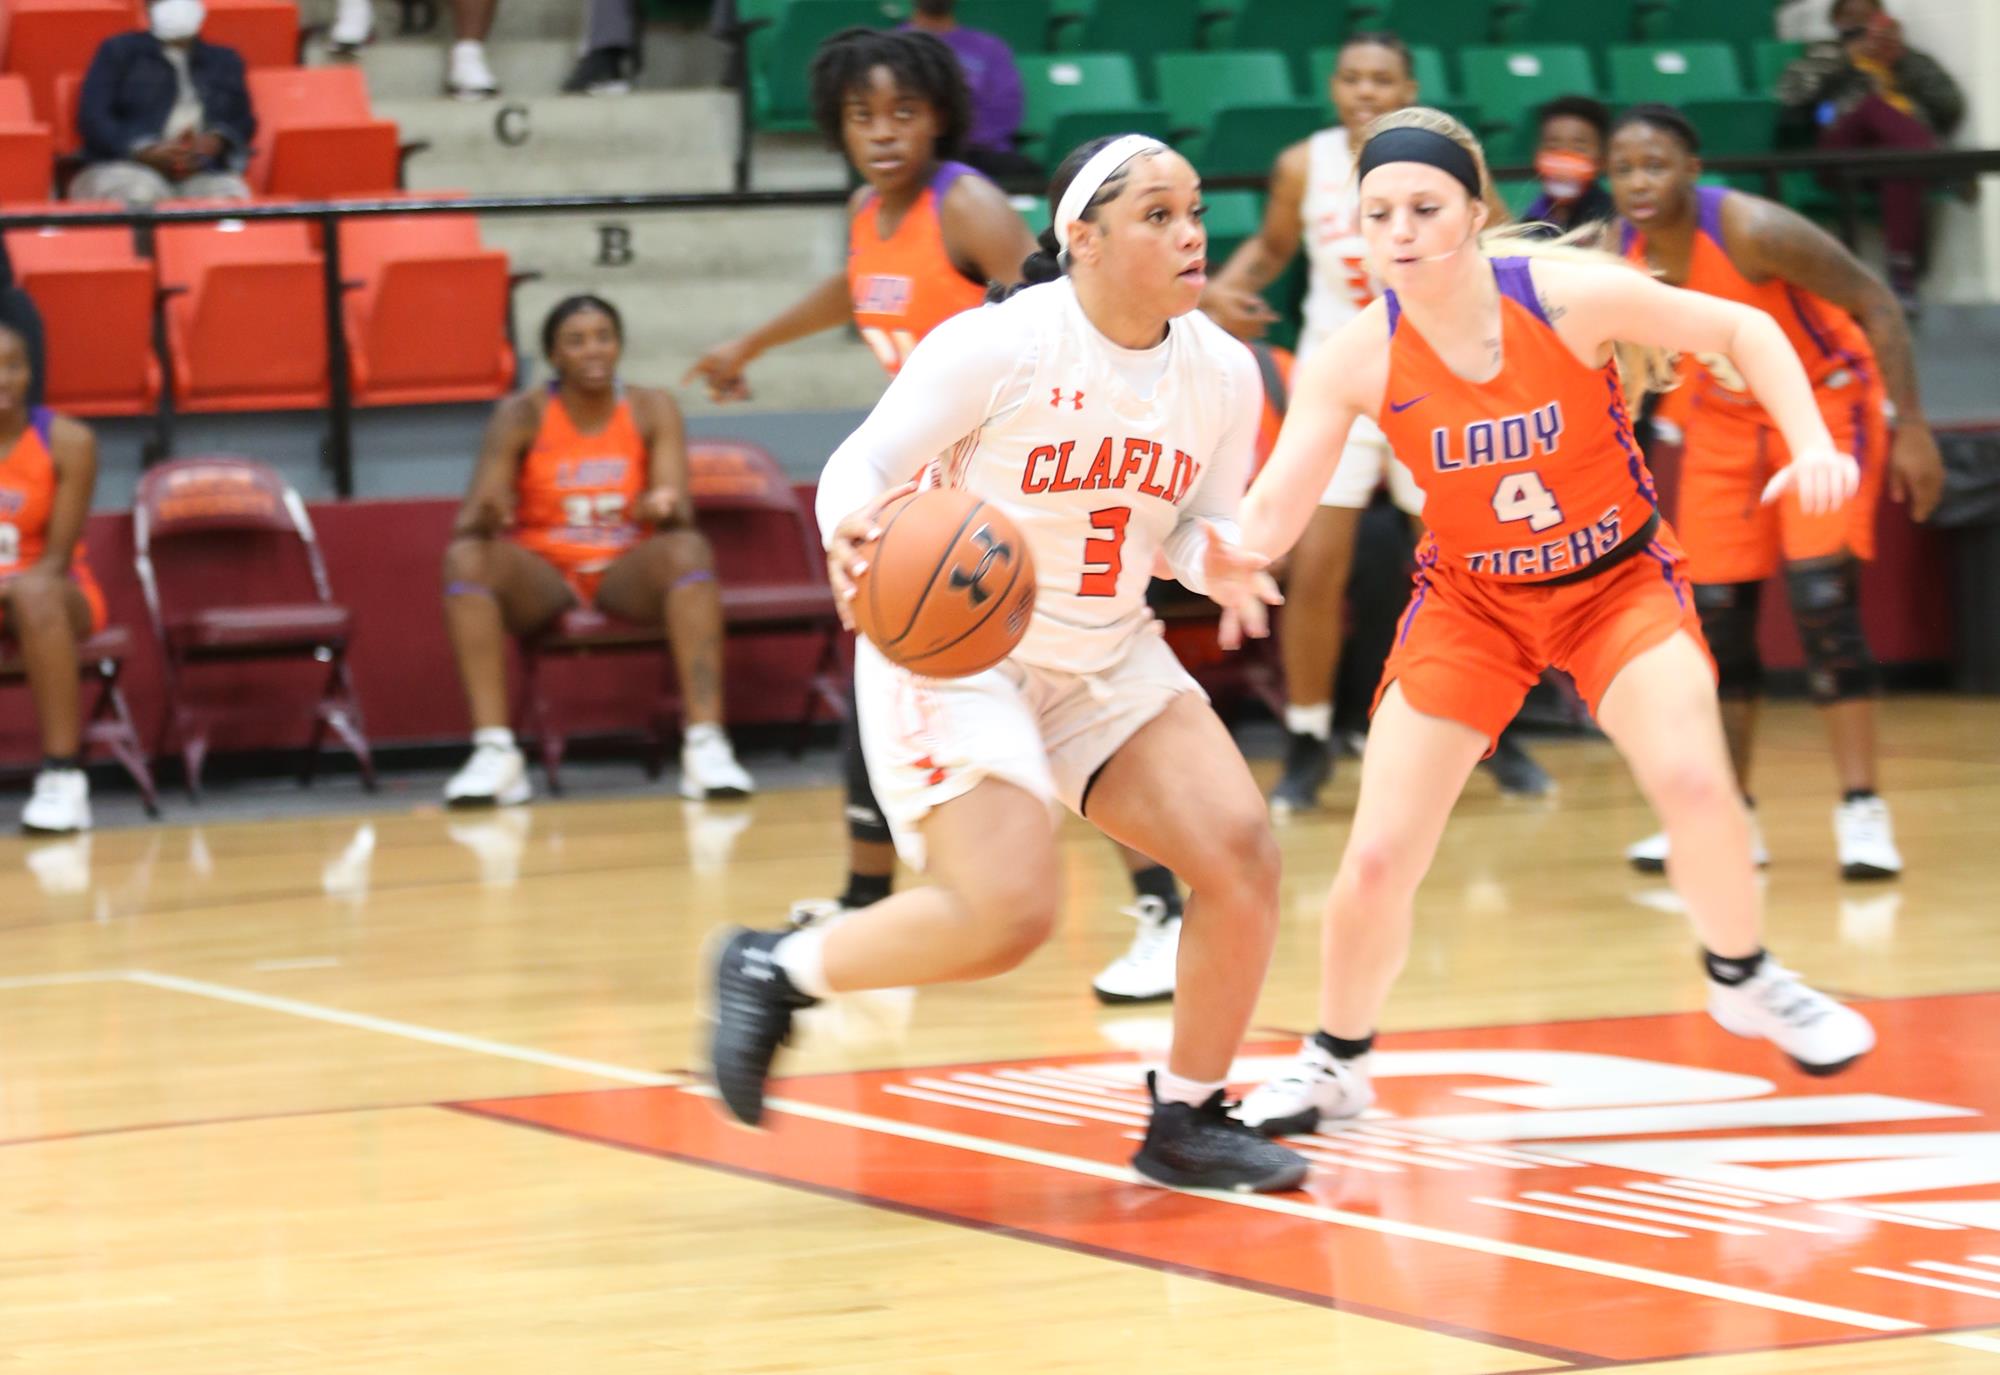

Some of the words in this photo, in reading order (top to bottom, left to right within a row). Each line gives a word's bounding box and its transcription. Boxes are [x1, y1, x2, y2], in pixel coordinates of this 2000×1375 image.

[495, 104, 531, 147] C
[595, 225, 634, 267] B
[1432, 400, 1564, 474] LADY
[1021, 436, 1201, 506] CLAFLIN
[1491, 471, 1564, 533] 4
[1077, 506, 1132, 597] 3
